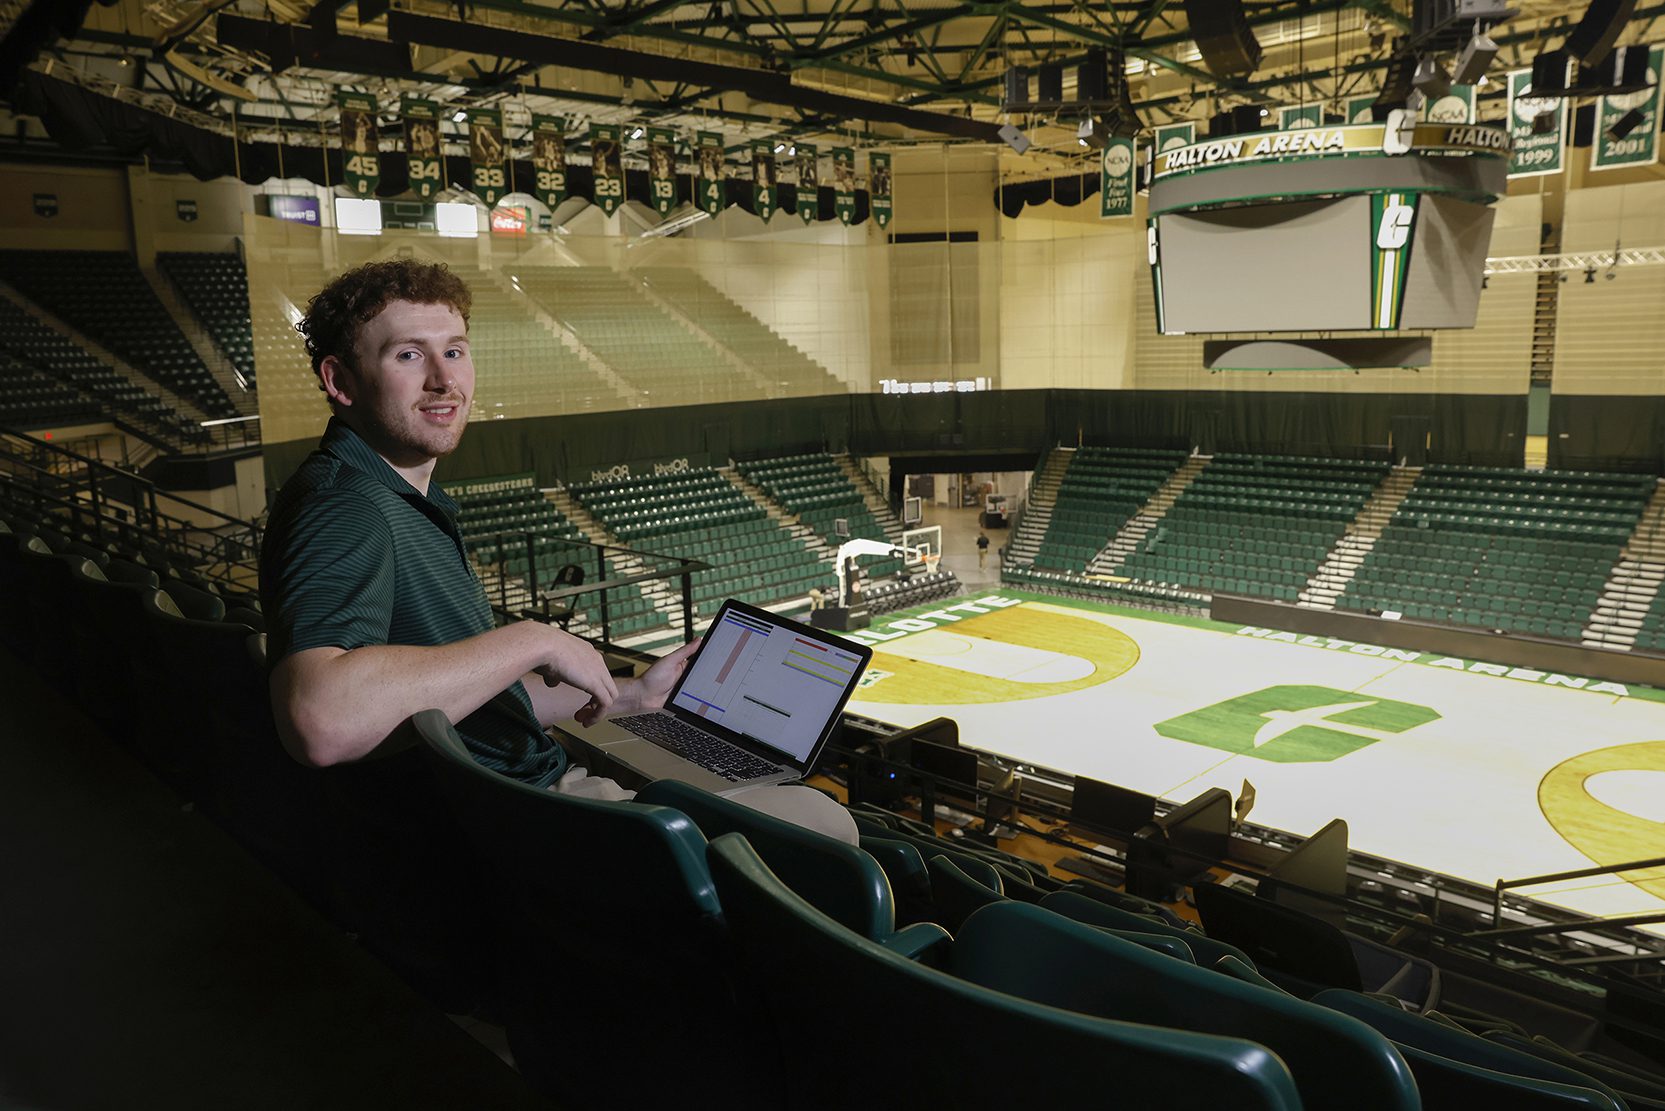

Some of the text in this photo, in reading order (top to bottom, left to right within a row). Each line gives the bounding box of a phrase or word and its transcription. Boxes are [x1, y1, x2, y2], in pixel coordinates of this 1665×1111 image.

[1448, 127, 1511, 150] HALTON
[1604, 138, 1646, 157] 2001
[1164, 131, 1345, 170] HALTON ARENA
[1518, 148, 1554, 167] 1999
[346, 156, 379, 176] 45
[409, 160, 440, 180] 34
[474, 167, 505, 187] 33
[537, 171, 565, 190] 32
[595, 178, 621, 196] 23
[654, 180, 673, 198] 13
[707, 187, 719, 201] 4
[758, 190, 770, 205] 4
[1106, 196, 1128, 209] 1977
[1237, 626, 1630, 696] HALTON ARENA
